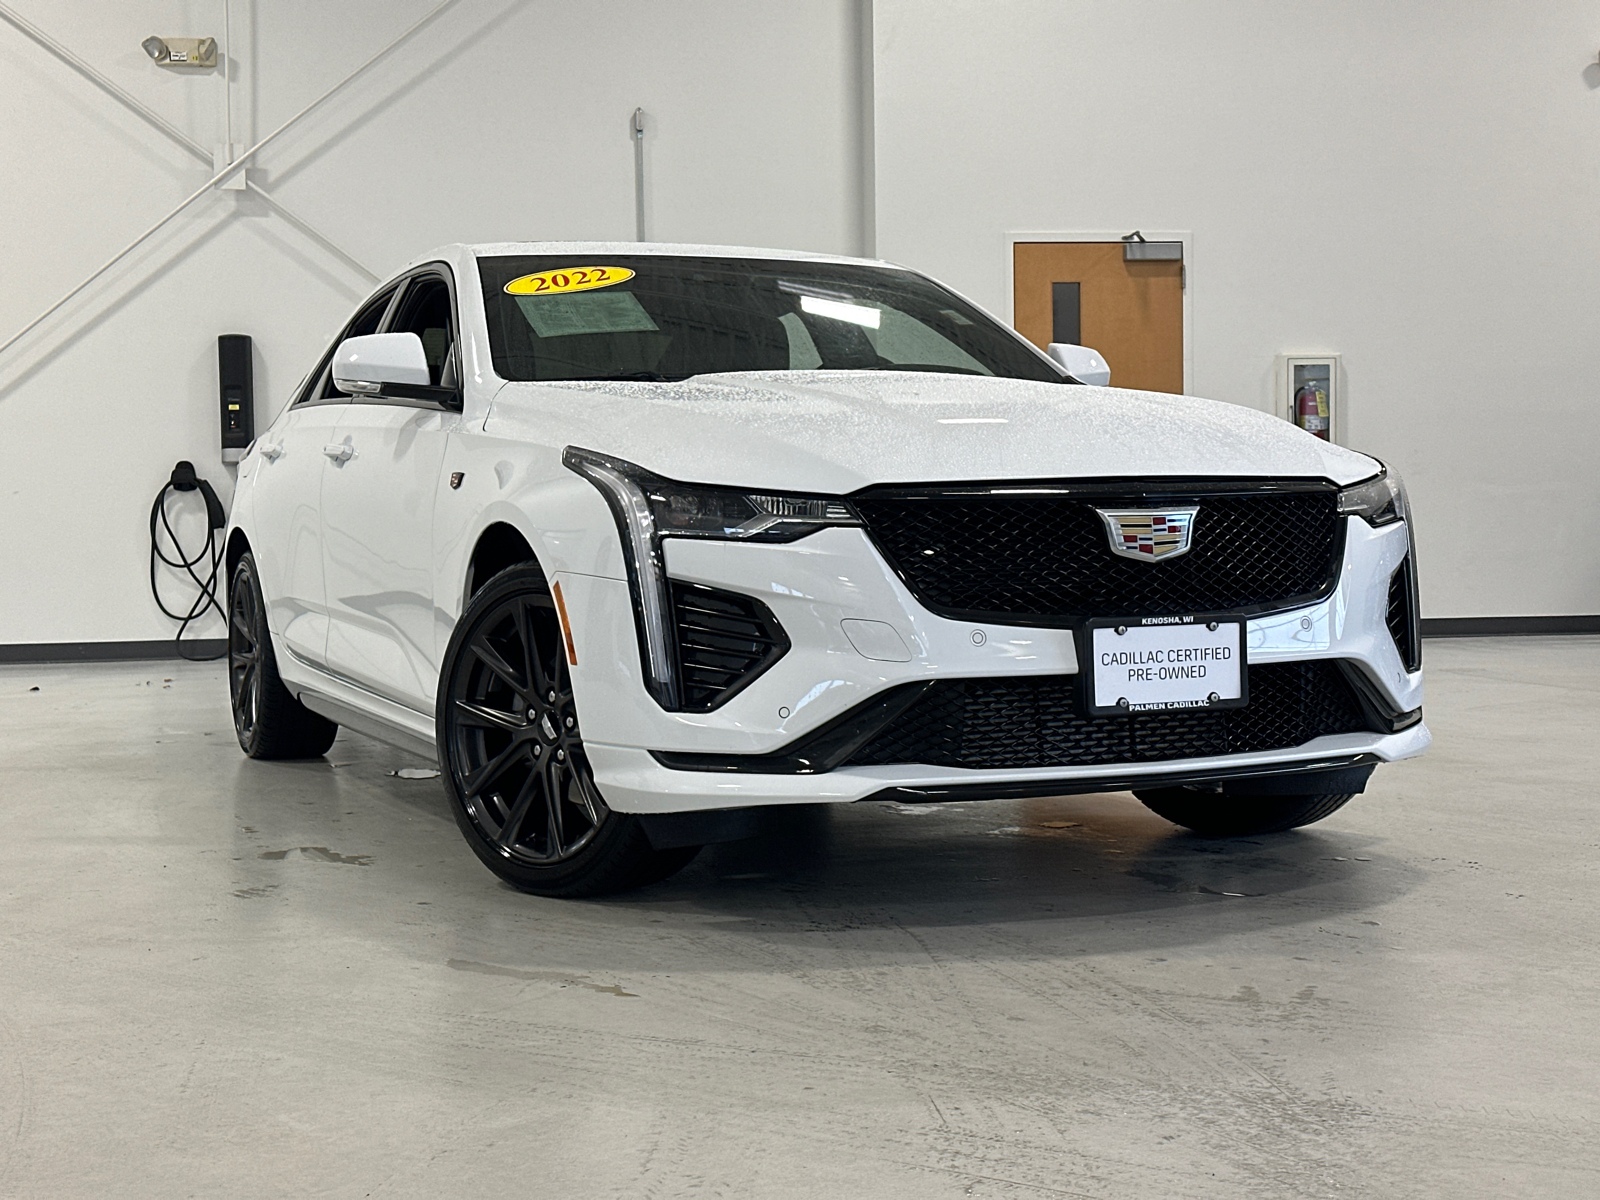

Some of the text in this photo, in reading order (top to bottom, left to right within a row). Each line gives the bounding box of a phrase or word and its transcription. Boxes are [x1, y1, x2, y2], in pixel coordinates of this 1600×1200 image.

[530, 268, 610, 292] 2022
[1141, 616, 1181, 625] KENOSHA,
[1101, 646, 1231, 666] CADILLAC CERTIFIED
[1128, 664, 1206, 681] PRE-OWNED
[1128, 700, 1210, 712] PALMEN CADILLAC
